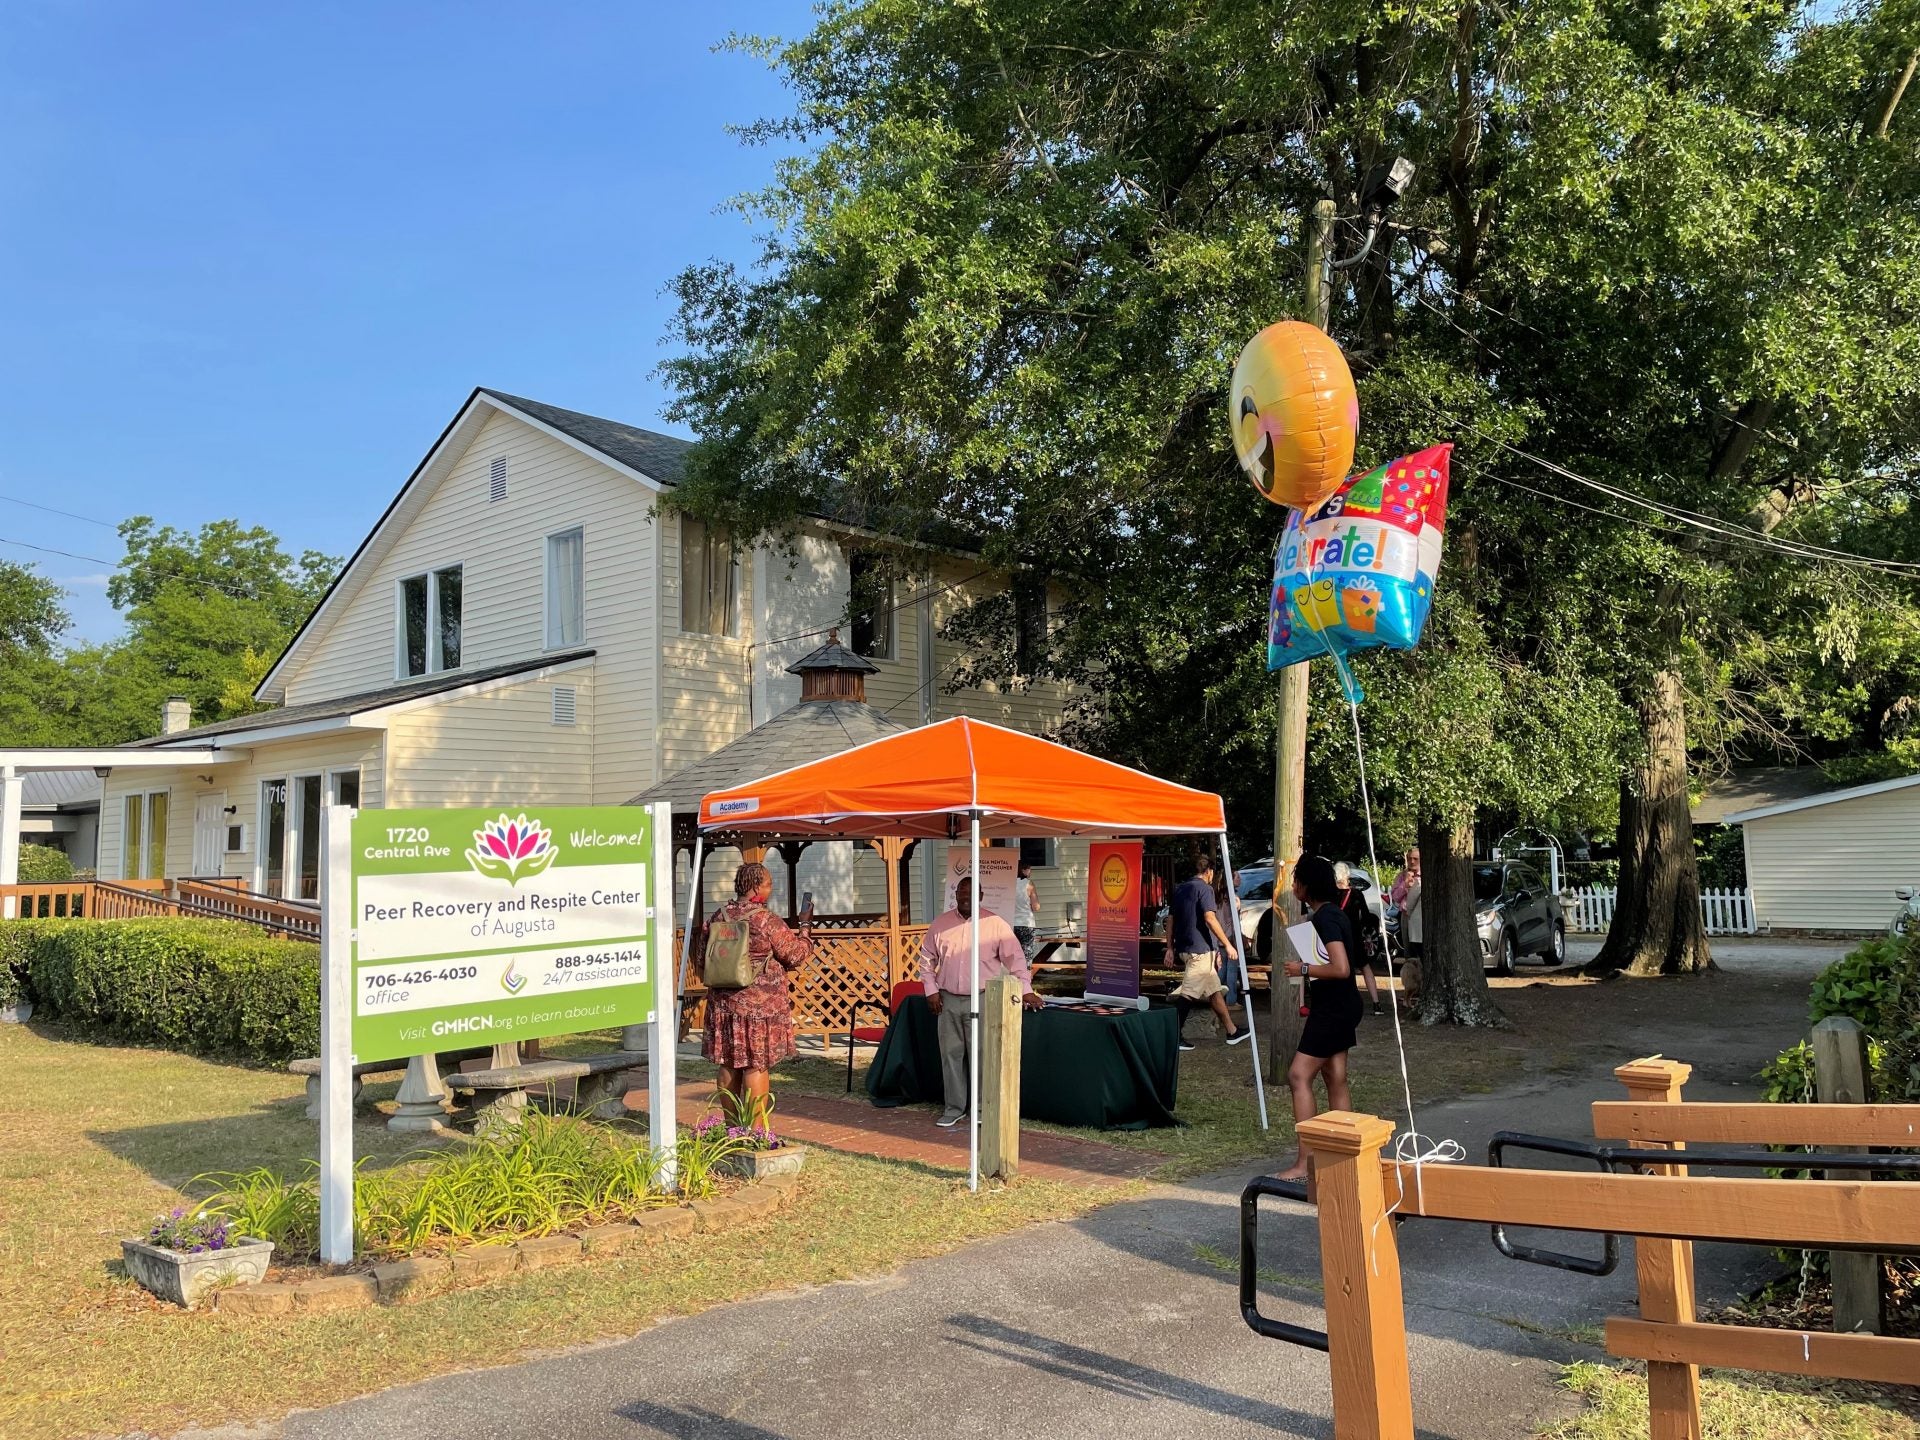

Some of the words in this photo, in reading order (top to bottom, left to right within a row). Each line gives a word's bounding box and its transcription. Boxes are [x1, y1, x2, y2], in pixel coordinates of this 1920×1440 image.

[266, 785, 286, 803] 1716
[720, 802, 748, 811] Academy
[386, 827, 430, 843] 1720
[569, 827, 644, 848] Welcome!
[364, 845, 420, 859] Central
[424, 845, 451, 857] Ave
[365, 904, 407, 921] Peer
[412, 901, 493, 918] Recovery
[497, 895, 526, 912] and
[530, 892, 587, 912] Respite
[591, 890, 641, 906] Center
[470, 919, 488, 936] of
[492, 917, 555, 938] Augusta
[555, 949, 642, 969] 888-945-1414
[365, 966, 477, 988] 706-426-4030
[543, 970, 573, 986] 24/7
[574, 965, 642, 982] assistance
[365, 989, 410, 1005] office
[399, 1027, 427, 1040] Visit
[431, 1014, 513, 1036] GMHCN.org
[516, 1014, 528, 1026] to
[530, 1009, 562, 1023] learn
[564, 1004, 600, 1018] about
[602, 1003, 616, 1014] us
